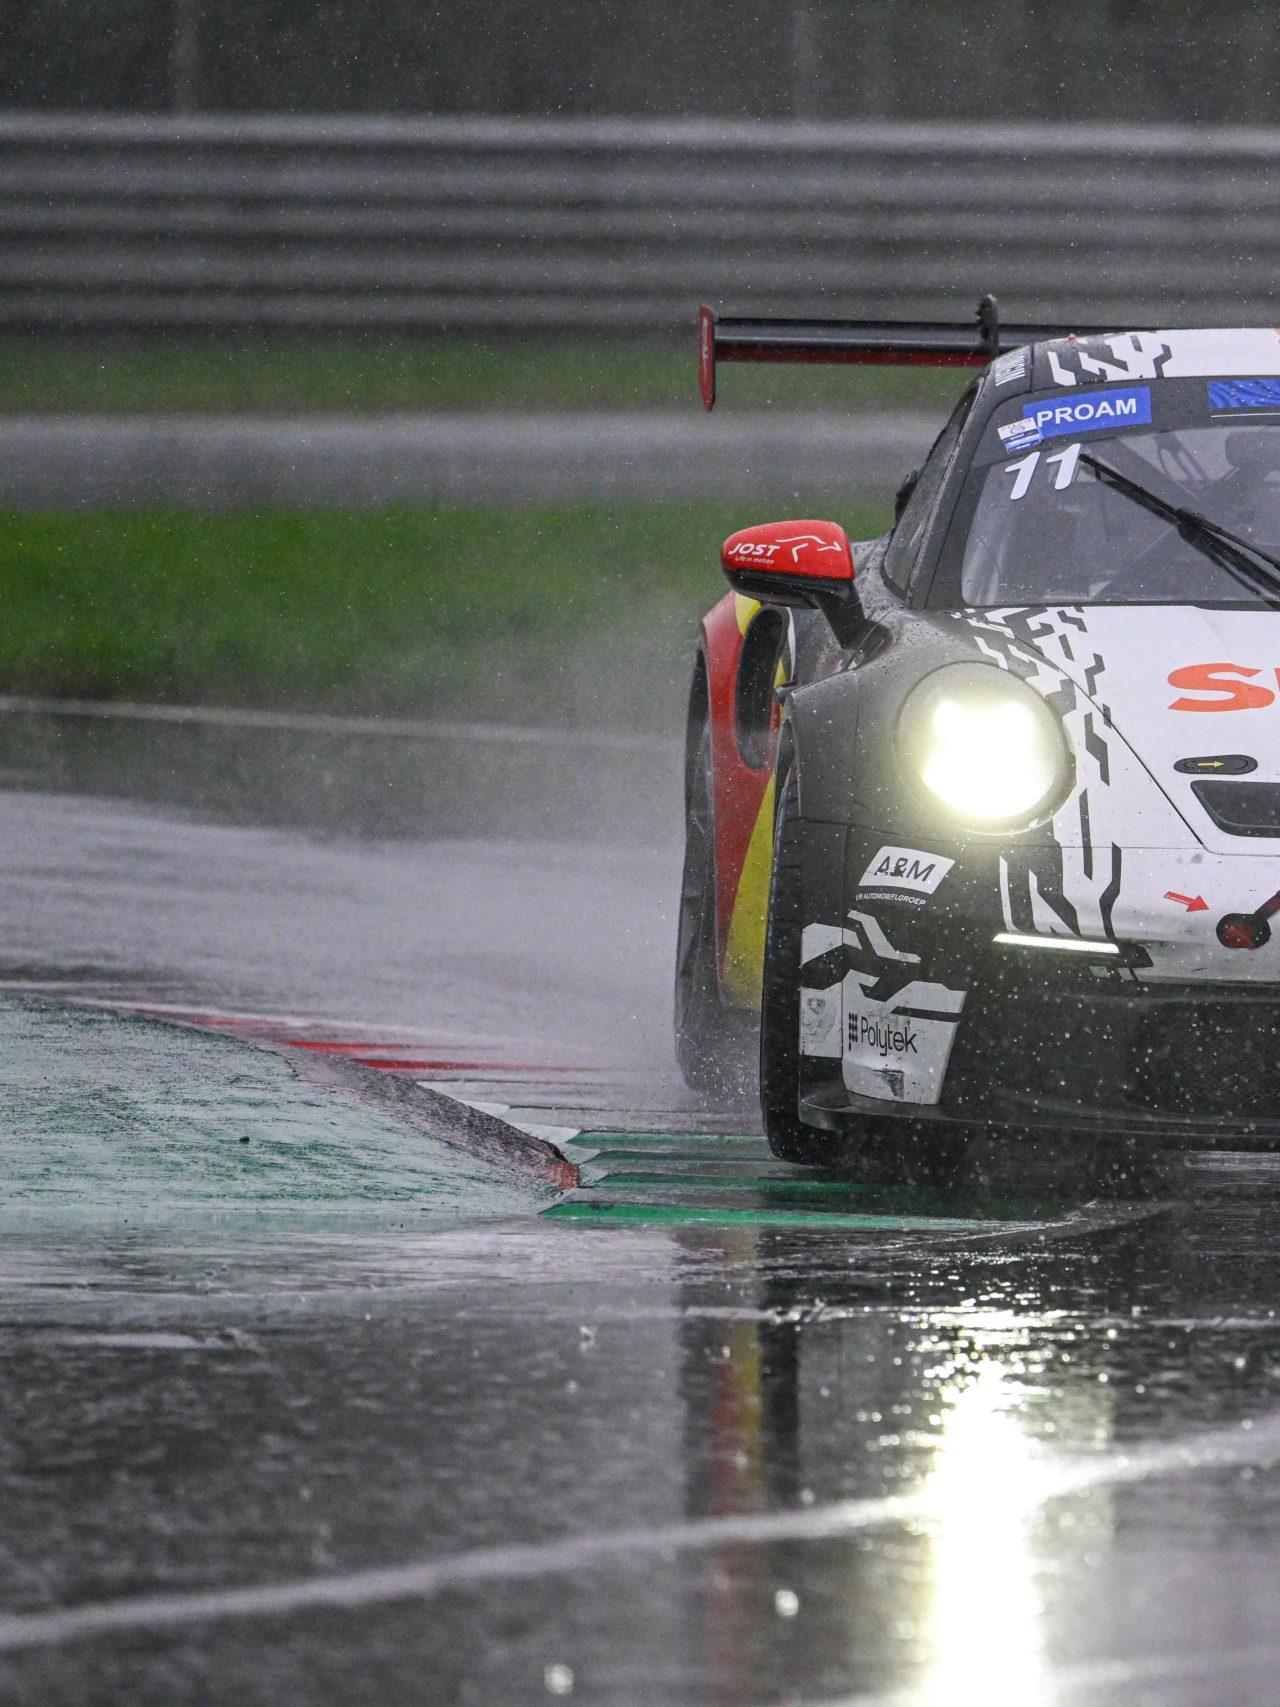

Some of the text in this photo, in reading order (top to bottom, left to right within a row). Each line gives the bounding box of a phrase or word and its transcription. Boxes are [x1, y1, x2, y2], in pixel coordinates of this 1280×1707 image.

[1037, 398, 1137, 427] PROAM
[1005, 443, 1081, 500] 11
[728, 542, 780, 557] JOST
[874, 855, 936, 882] A&M
[860, 1016, 918, 1056] Polytek
